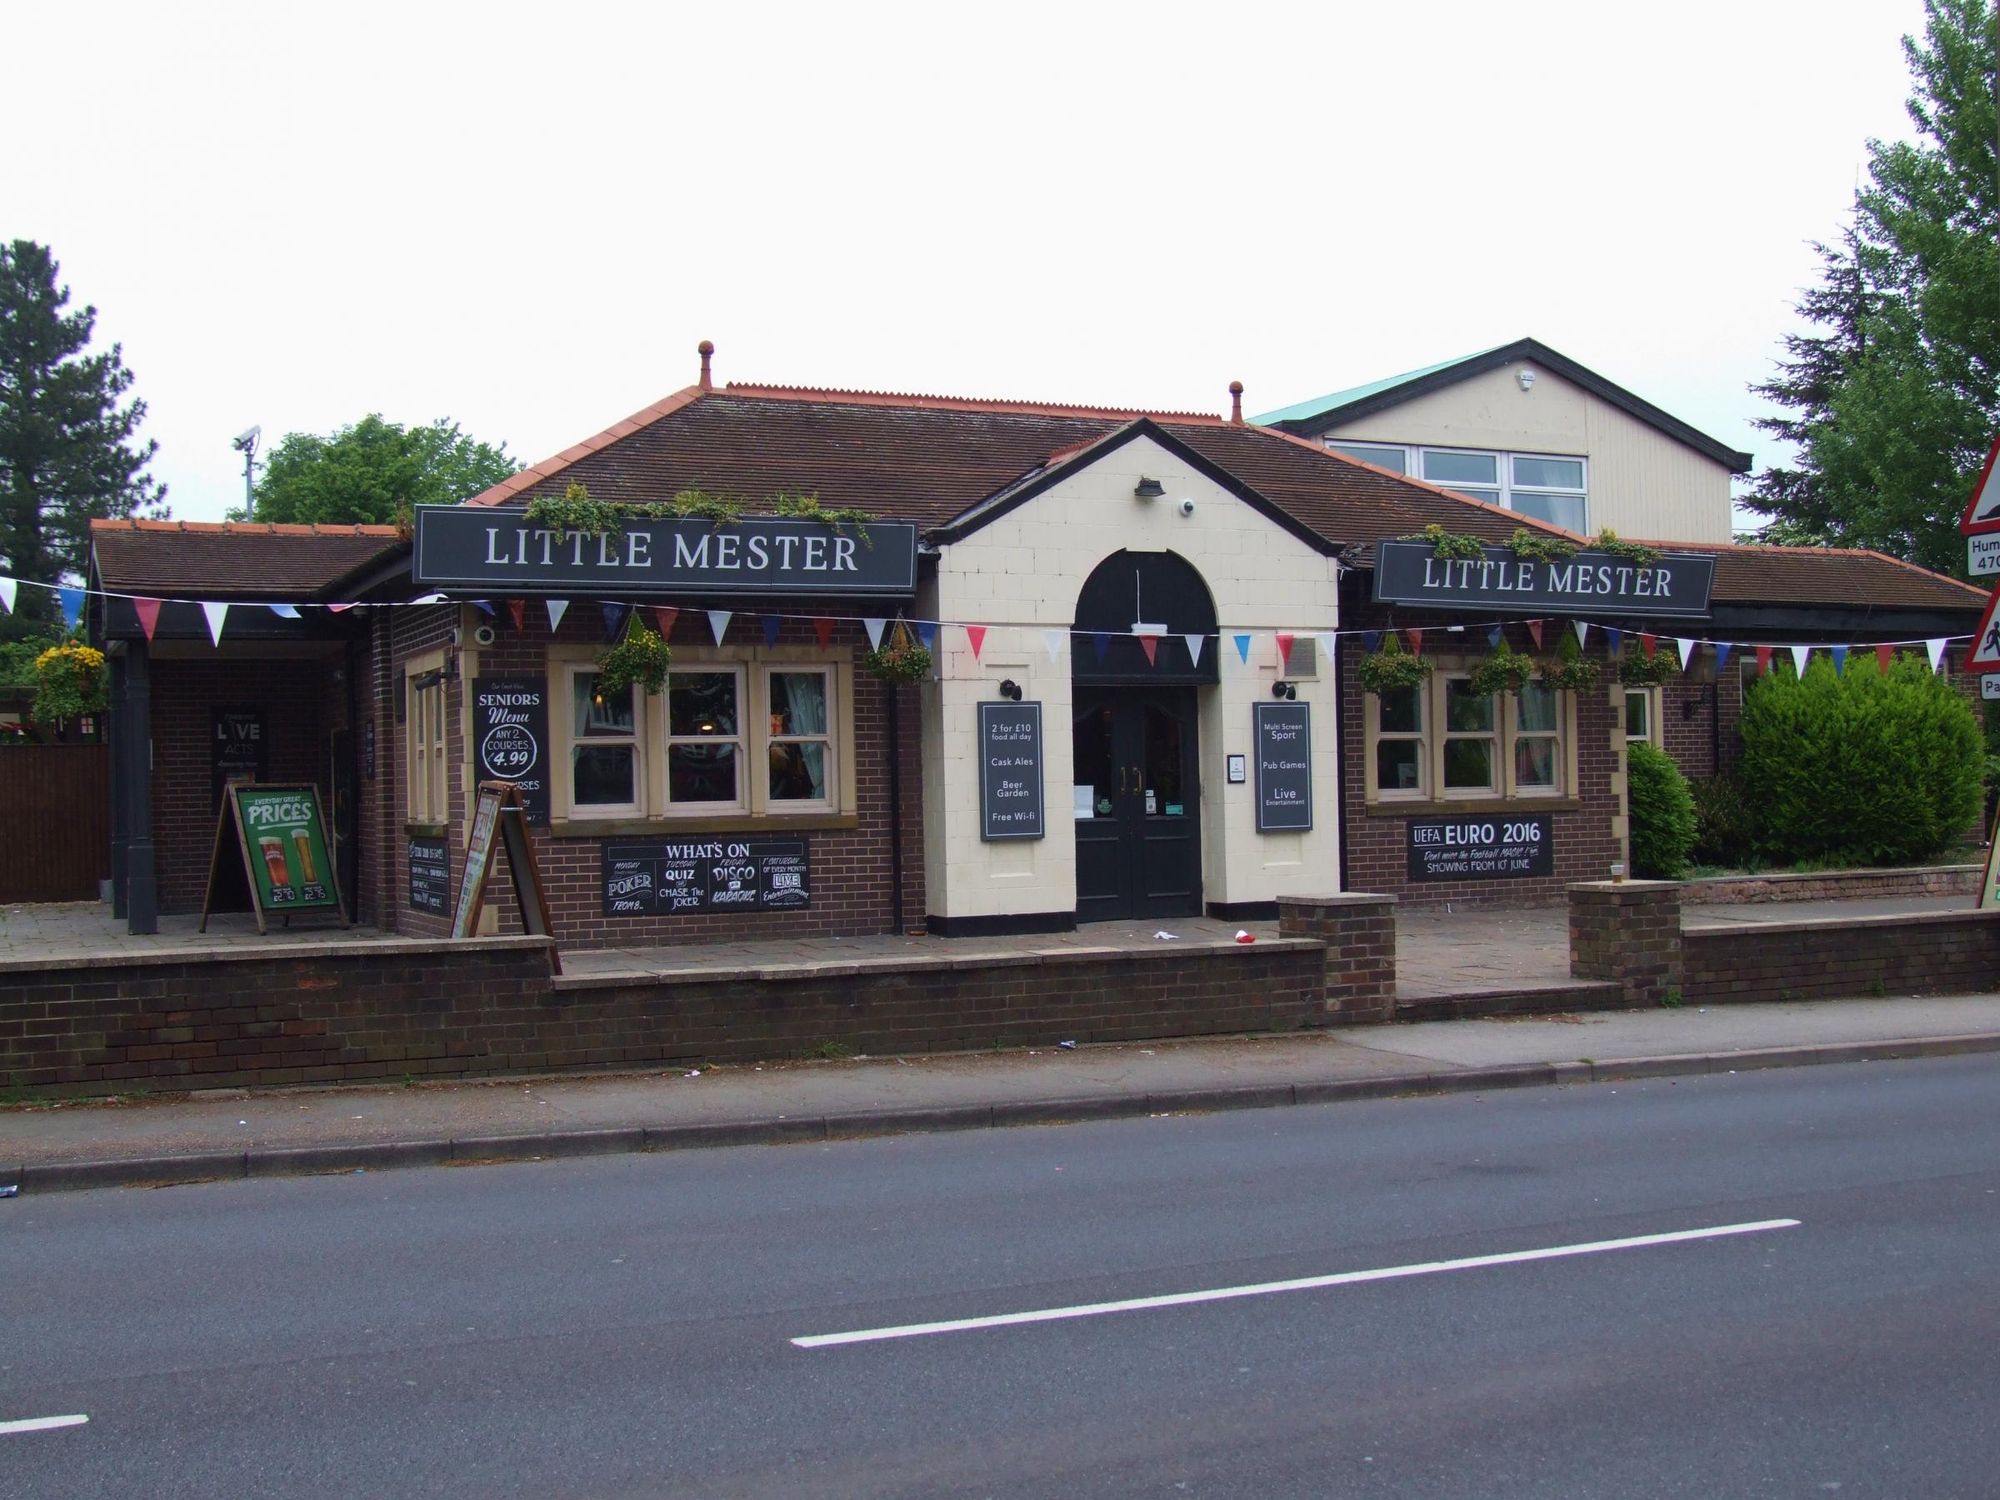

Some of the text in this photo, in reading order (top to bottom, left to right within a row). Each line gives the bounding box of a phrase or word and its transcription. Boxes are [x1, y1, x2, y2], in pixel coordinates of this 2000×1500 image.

[485, 528, 859, 572] LITTLE MESTER
[1423, 558, 1672, 597] LITTLE MESTER
[479, 694, 540, 706] SENIORS
[488, 707, 530, 724] Menu
[992, 723, 1031, 732] 2 for £10
[496, 729, 520, 739] ANY 2
[991, 733, 1008, 741] food
[1019, 734, 1032, 742] day
[1271, 730, 1296, 741] Sport
[487, 740, 528, 750] COURSES
[991, 757, 1034, 766] Cask Ales
[1263, 760, 1306, 770] Pub Games
[1002, 780, 1023, 789] Beer
[996, 789, 1029, 798] Garden
[1273, 787, 1297, 799] Live
[992, 812, 1012, 821] Free
[1413, 822, 1541, 845] UEFA EURO 2016
[666, 841, 750, 859] WHAT'S ON
[720, 858, 747, 867] FRIDAY
[1427, 861, 1468, 873] SHOWING
[1471, 860, 1495, 871] FROM
[1510, 858, 1530, 872] JUNE
[665, 869, 695, 881] QUIZ
[712, 866, 756, 881] DISCO
[608, 874, 652, 896] POKER
[774, 873, 801, 888] LIVE
[659, 888, 689, 898] CHASE
[712, 889, 757, 903] KARAOKE
[672, 896, 701, 911] JOKER
